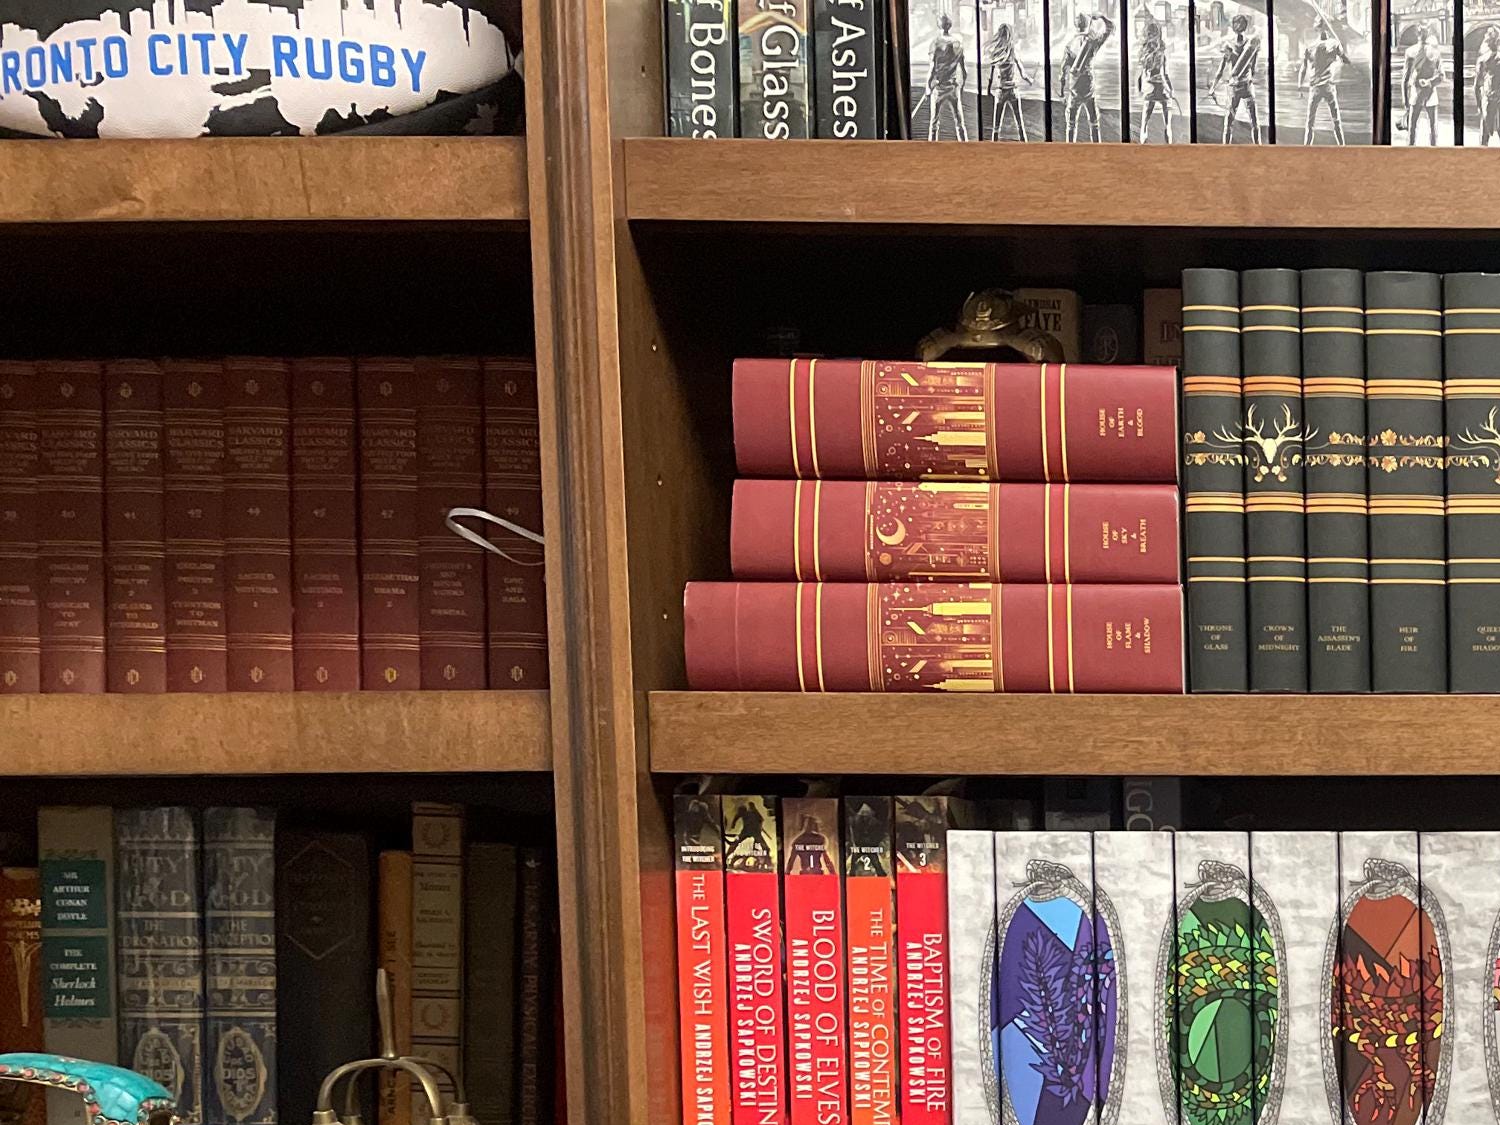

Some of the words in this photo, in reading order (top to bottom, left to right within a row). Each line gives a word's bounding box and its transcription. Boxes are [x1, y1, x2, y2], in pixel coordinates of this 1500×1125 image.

[147, 33, 249, 76] CITY
[272, 35, 428, 92] RUGBY
[761, 24, 800, 140] Glass
[831, 16, 868, 138] Ashes
[692, 873, 705, 900] THE
[863, 857, 871, 871] 2
[920, 853, 927, 866] 3
[690, 905, 711, 954] LAST
[870, 908, 883, 937] THE
[734, 944, 754, 1011] ANDRZEJ
[752, 908, 775, 997] SWORD
[792, 939, 811, 1005] ANDRZEJ
[812, 910, 837, 1002] BLOOD
[852, 947, 869, 1013] ANDRZEJ
[870, 942, 888, 994] TIME
[906, 942, 924, 1008] ANDRZEJ
[923, 933, 944, 1029] BAPTISM
[51, 977, 97, 990] Sherlock
[54, 995, 95, 1007] Holmes
[693, 959, 712, 1015] WISH
[872, 999, 885, 1018] OF
[755, 1005, 775, 1036] OF
[815, 1012, 839, 1047] OF
[927, 1037, 942, 1059] OF
[694, 1023, 713, 1082] ANDRZEJ
[737, 1019, 757, 1107] SAPKOWSKI
[794, 1013, 813, 1099] SAPKOWSKI
[853, 1022, 871, 1108] SAPKOWSKI
[907, 1017, 926, 1103] SAPKOWSKI
[816, 1057, 841, 1125] ELVES
[926, 1067, 946, 1112] FIRE
